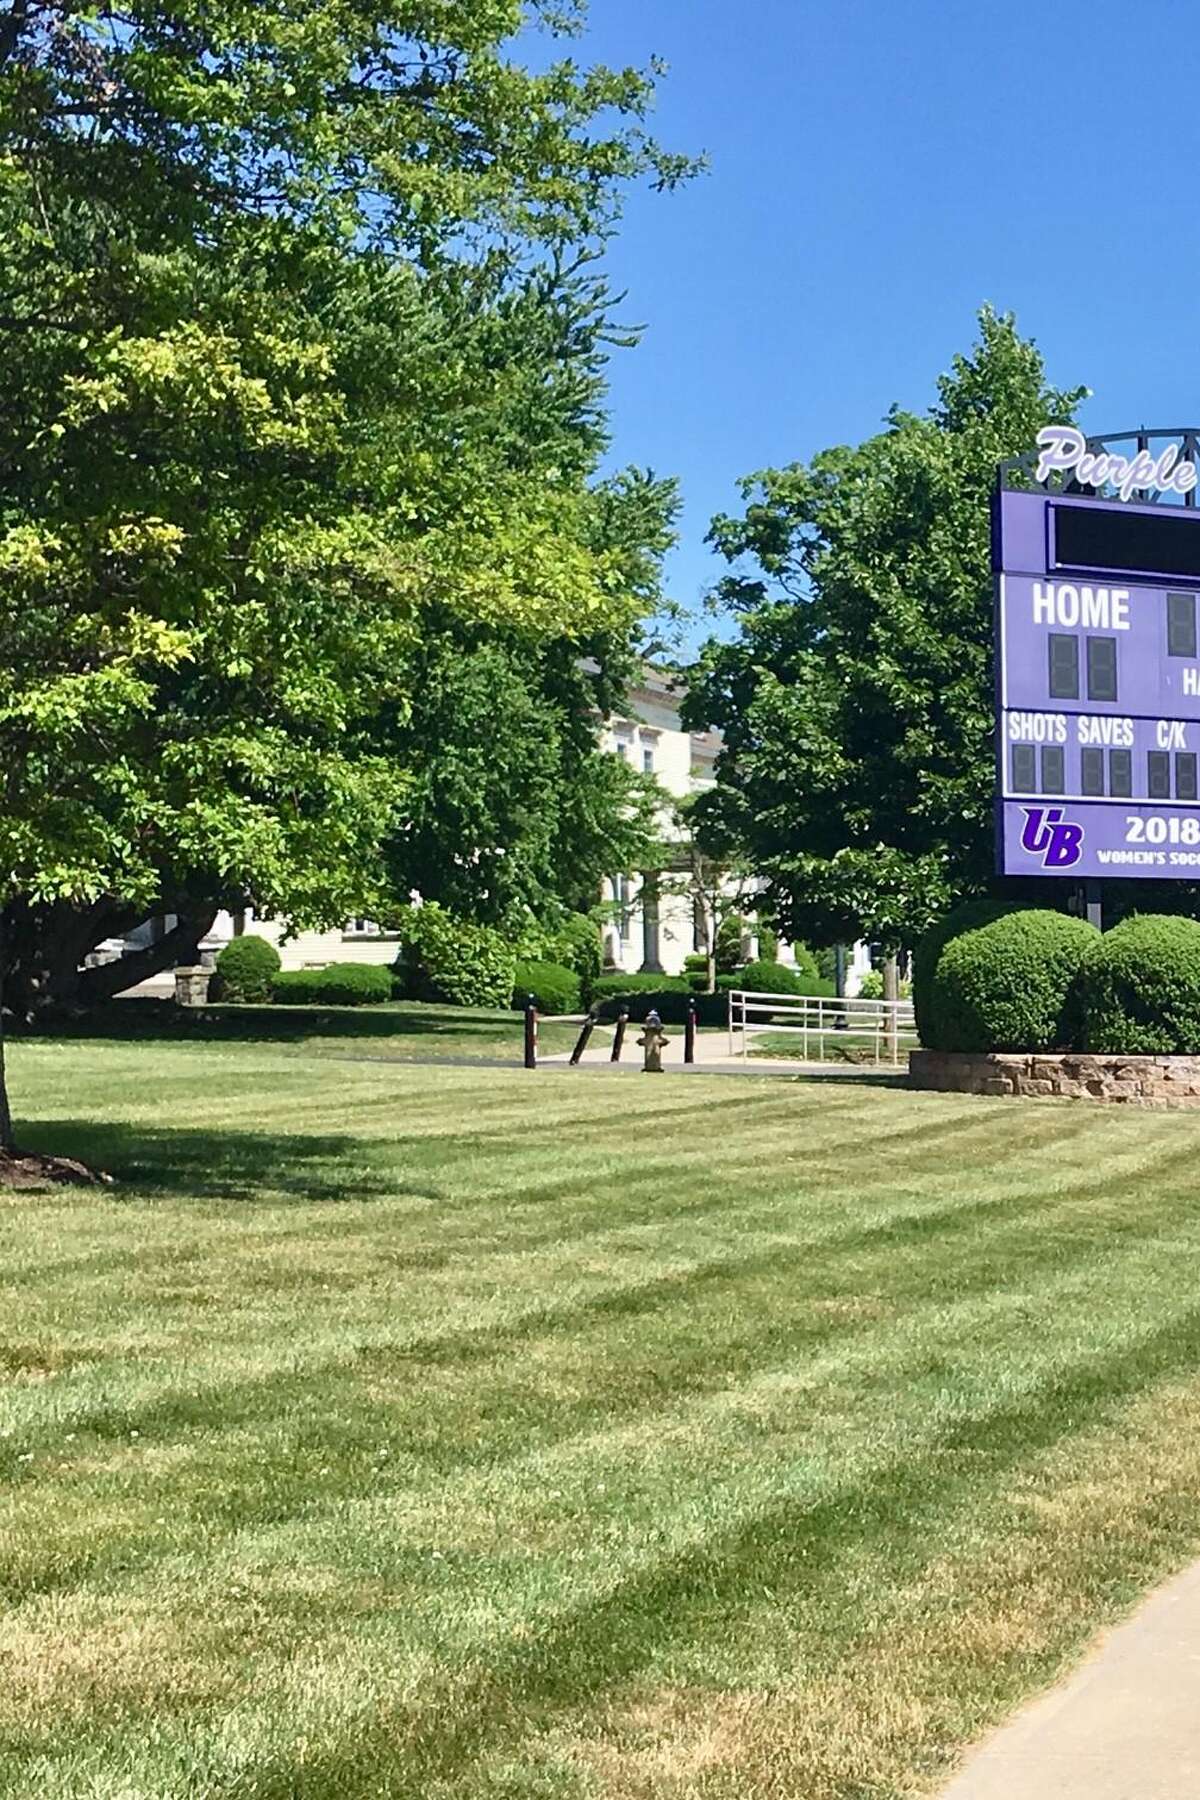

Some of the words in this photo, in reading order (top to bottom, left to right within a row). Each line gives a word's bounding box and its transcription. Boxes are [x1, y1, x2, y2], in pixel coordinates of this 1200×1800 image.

[1035, 425, 1198, 502] Purple
[1032, 582, 1131, 630] HOME
[1008, 711, 1067, 742] SHOTS
[1077, 715, 1134, 746] SAVES
[1156, 720, 1187, 750] C/K
[1018, 806, 1085, 869] UB
[1125, 816, 1200, 845] 2018
[1096, 849, 1166, 865] WOMEN'S
